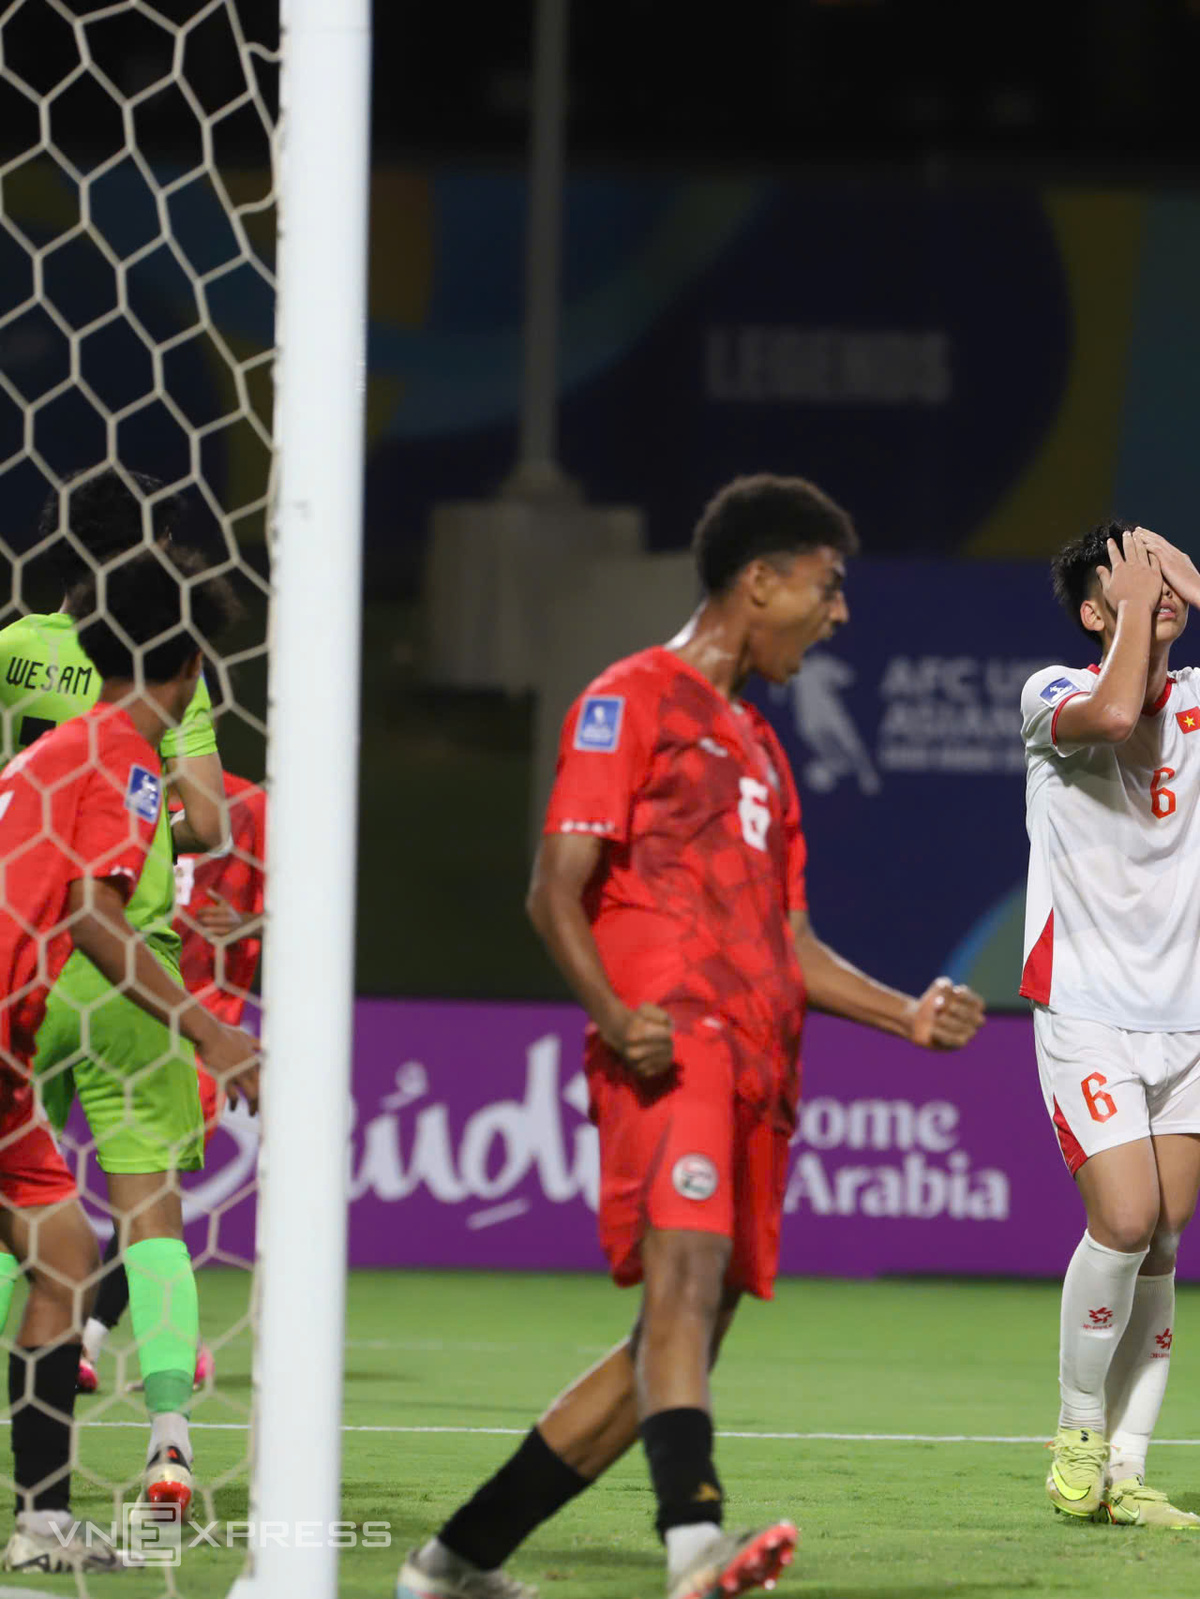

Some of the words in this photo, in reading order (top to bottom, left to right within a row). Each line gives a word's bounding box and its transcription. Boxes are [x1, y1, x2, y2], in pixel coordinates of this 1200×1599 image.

[6, 657, 92, 695] WESAM
[738, 776, 770, 852] 6
[1150, 767, 1176, 819] 6
[1081, 1071, 1118, 1123] 6
[783, 1152, 1009, 1221] Arabia
